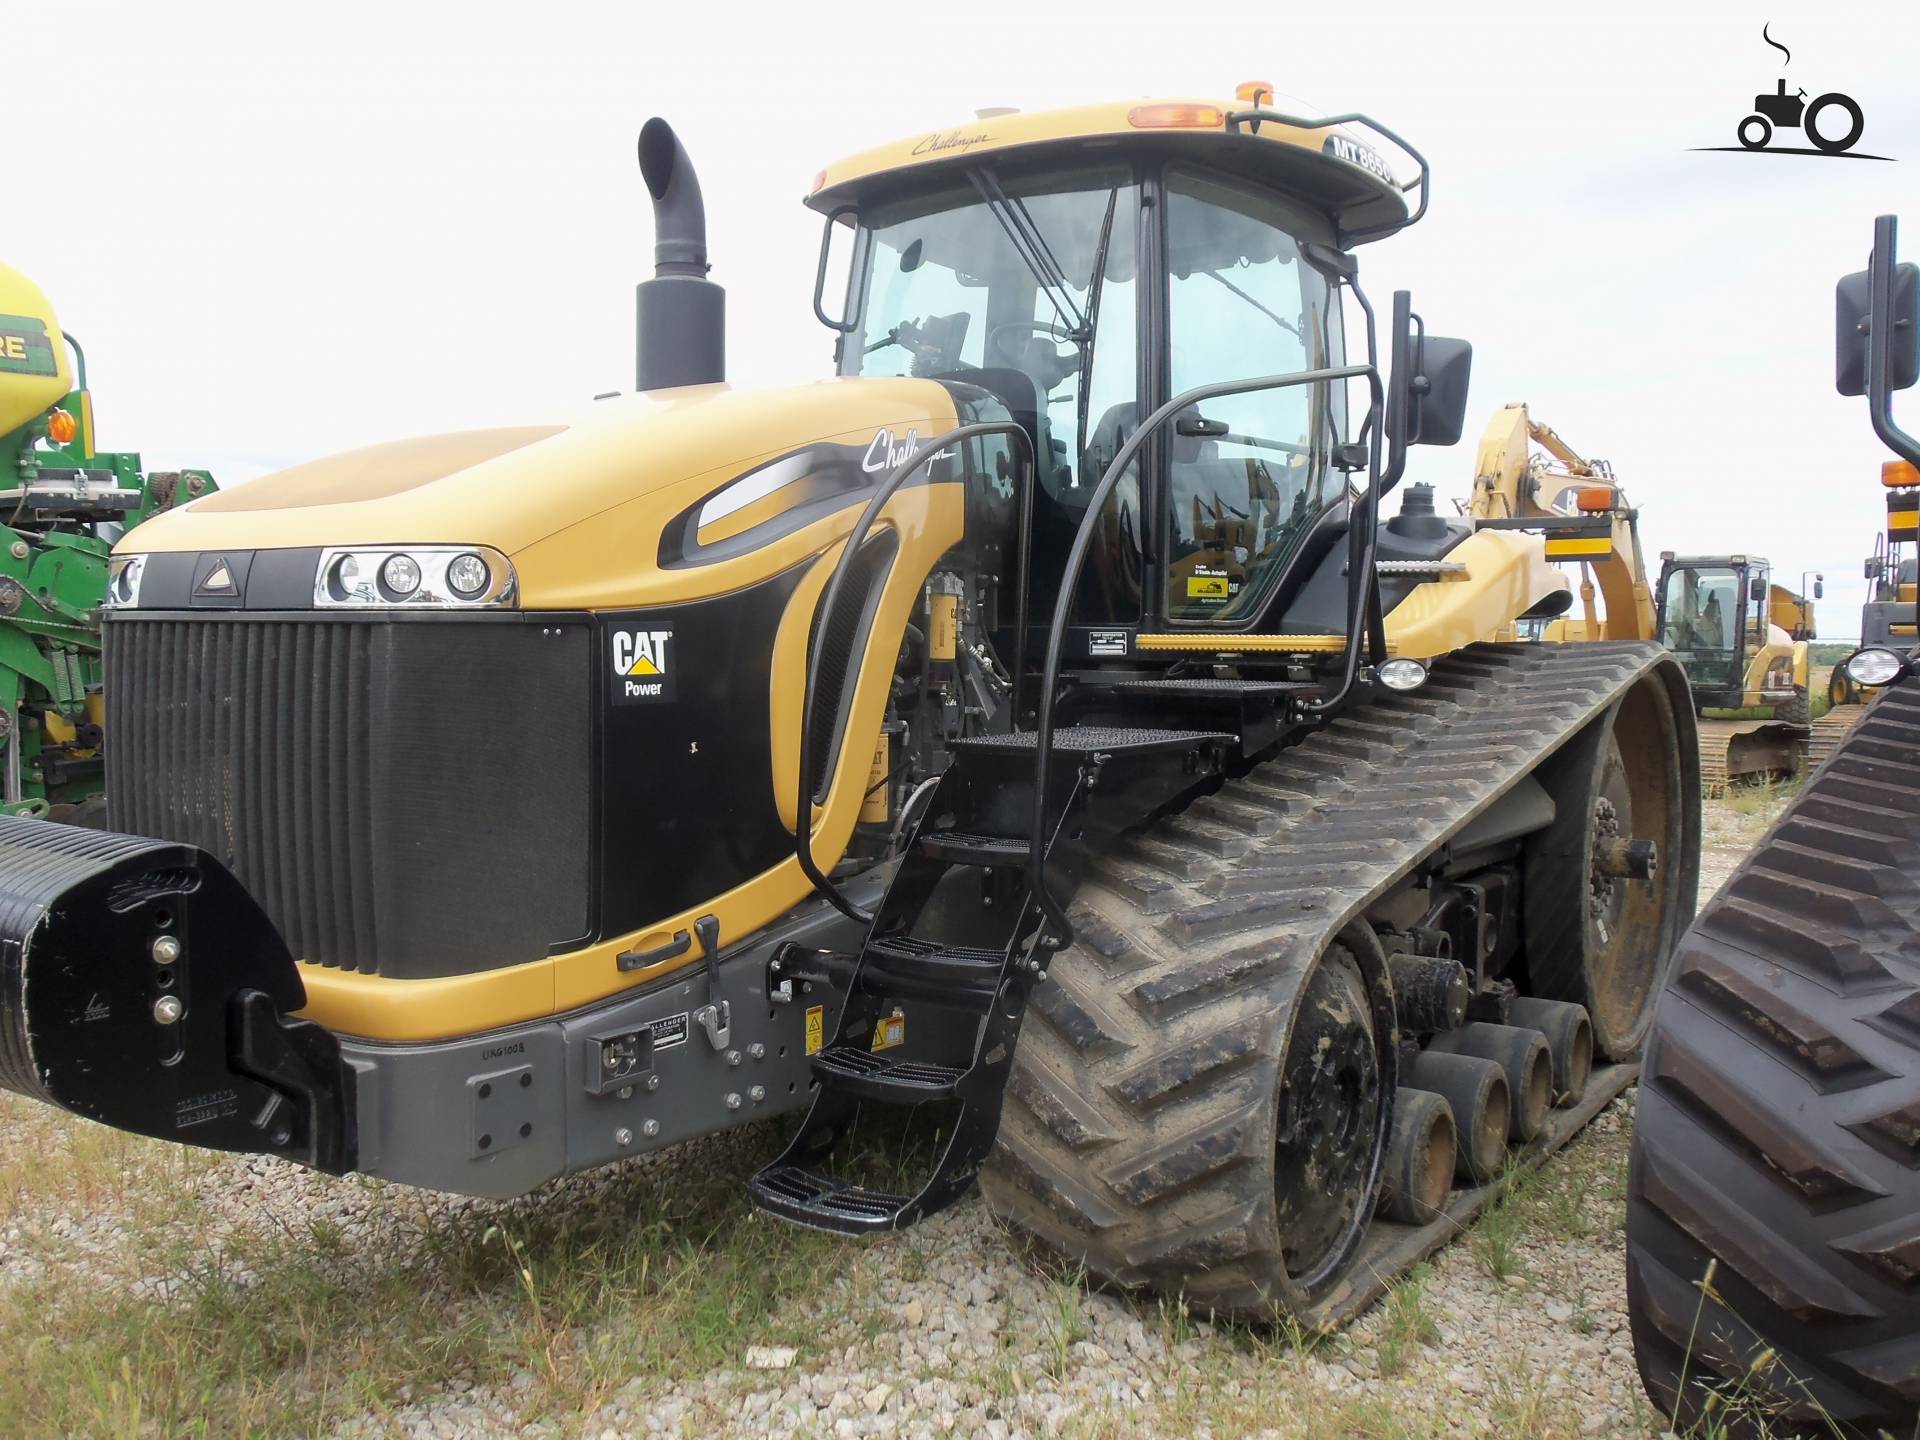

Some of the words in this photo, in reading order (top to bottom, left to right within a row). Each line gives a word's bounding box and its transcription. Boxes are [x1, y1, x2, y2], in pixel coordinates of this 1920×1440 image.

[911, 130, 1000, 156] Challenger
[1333, 136, 1358, 162] MT
[613, 631, 668, 675] CAT
[625, 680, 662, 696] Power
